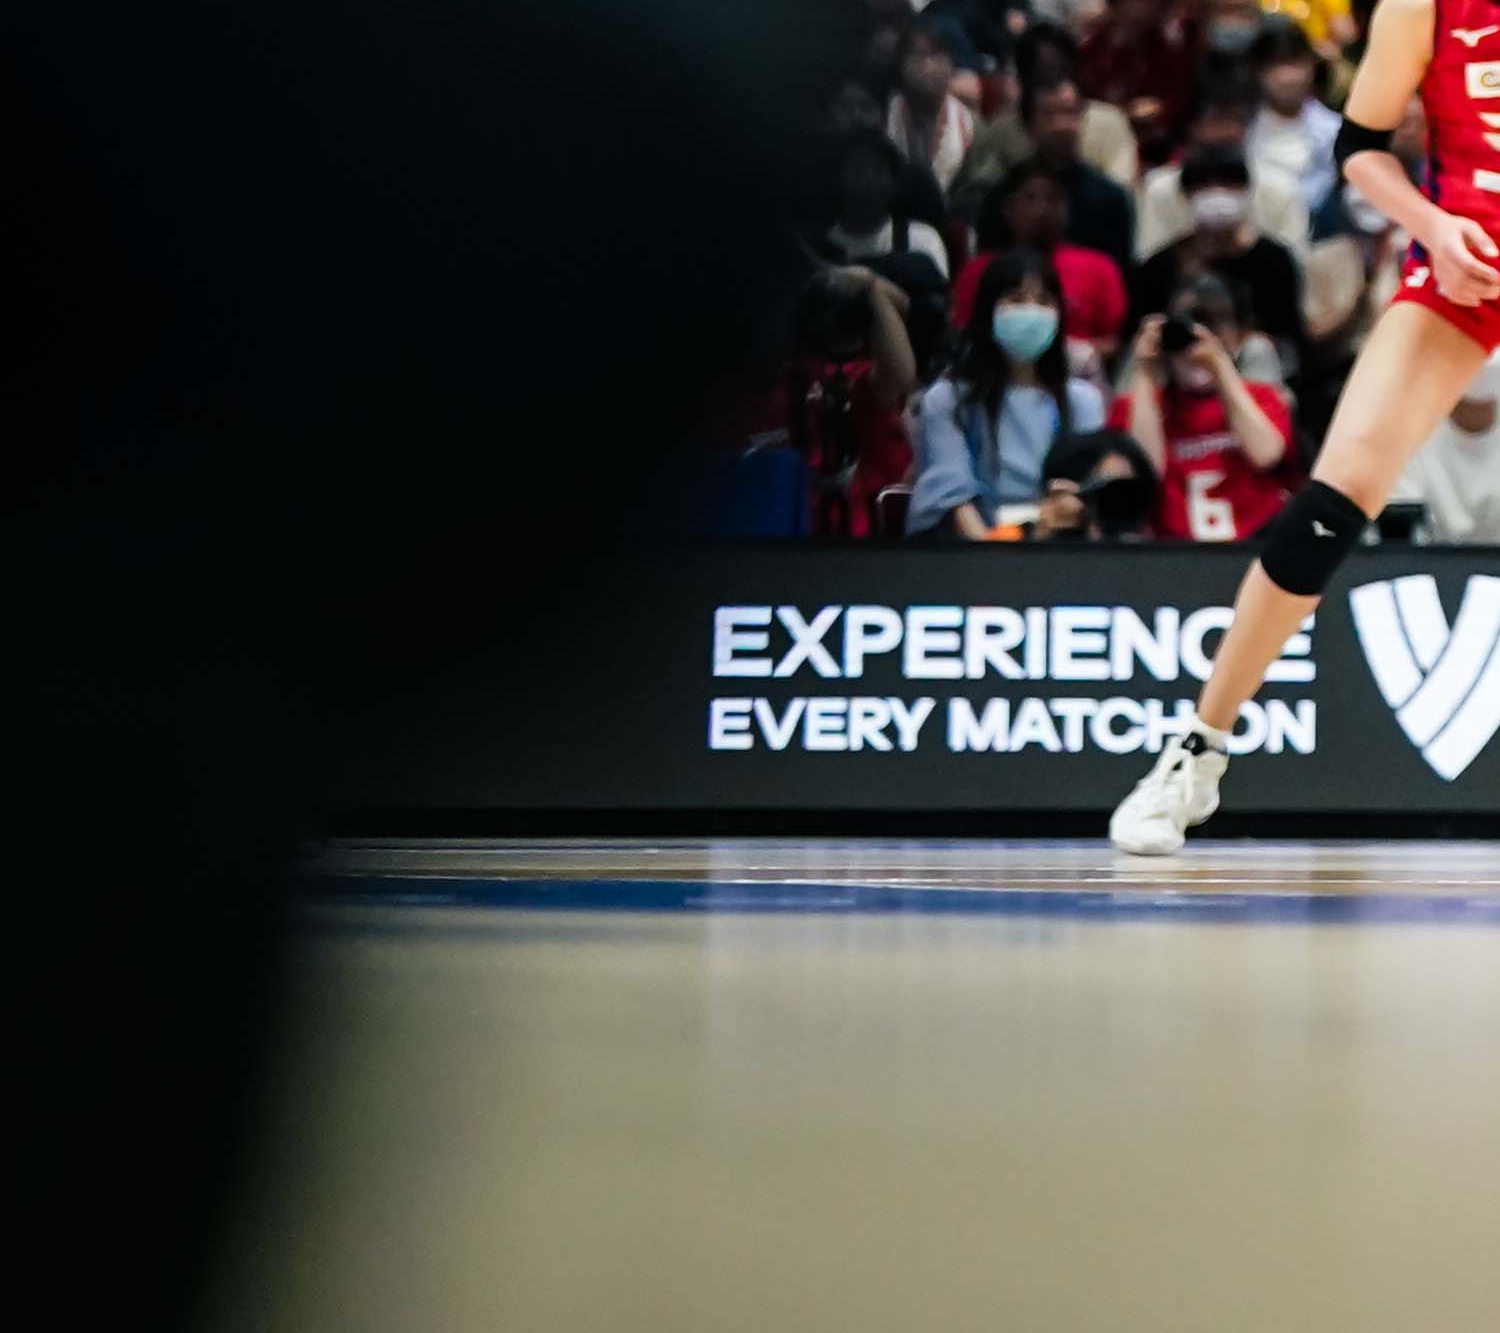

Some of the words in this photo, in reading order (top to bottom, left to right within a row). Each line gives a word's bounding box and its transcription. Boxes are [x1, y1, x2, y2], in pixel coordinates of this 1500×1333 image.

[1187, 469, 1238, 543] 6
[709, 696, 937, 752] EVERY
[946, 696, 1203, 755] MATCH
[1227, 698, 1317, 755] ON
